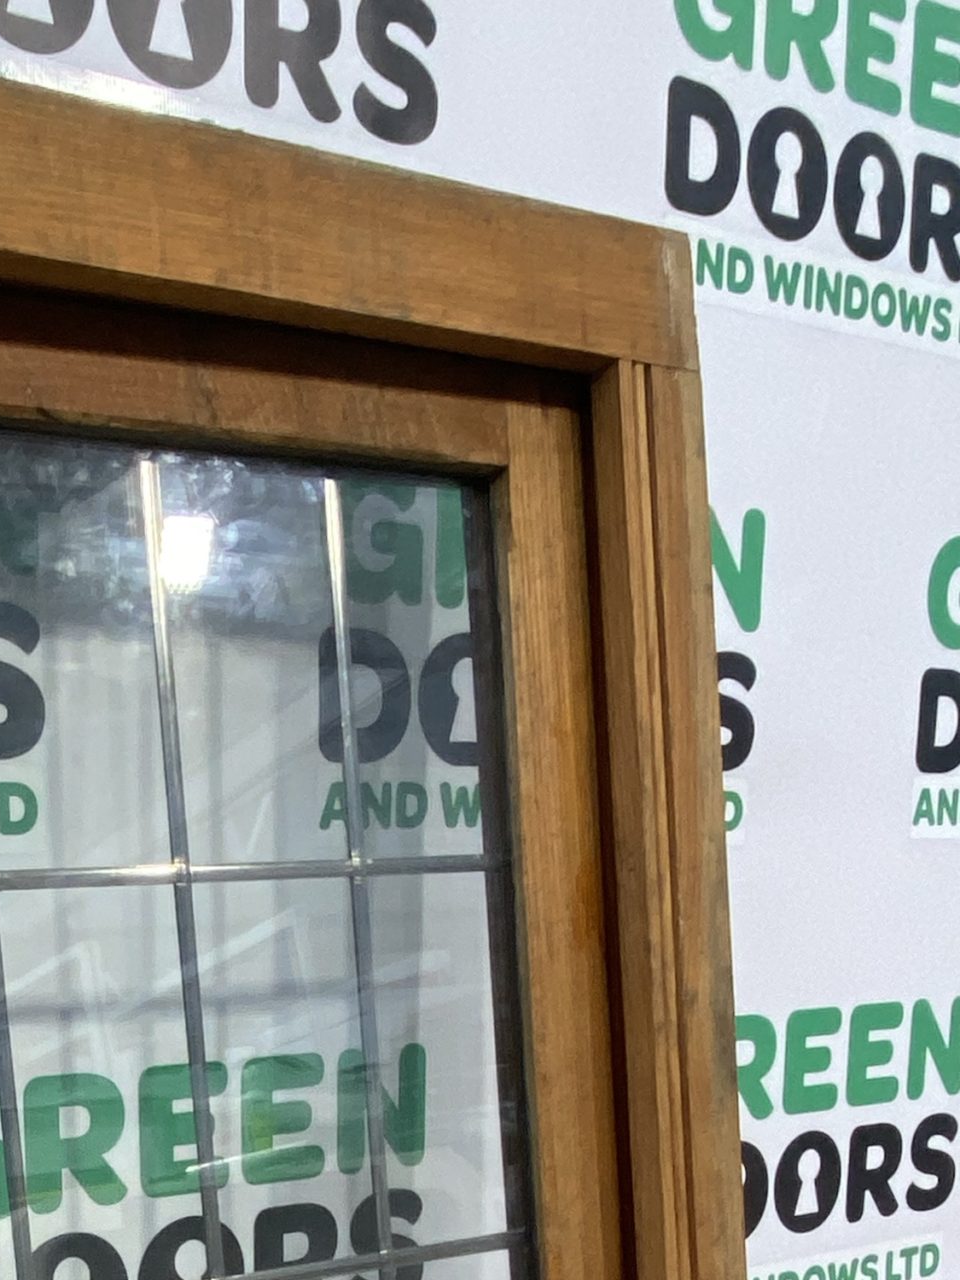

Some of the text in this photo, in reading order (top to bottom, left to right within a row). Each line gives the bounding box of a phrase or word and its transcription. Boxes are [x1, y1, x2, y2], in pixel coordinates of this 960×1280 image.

[665, 75, 960, 283] DOOR
[764, 255, 951, 342] WINDOWS
[319, 782, 429, 831] AND
